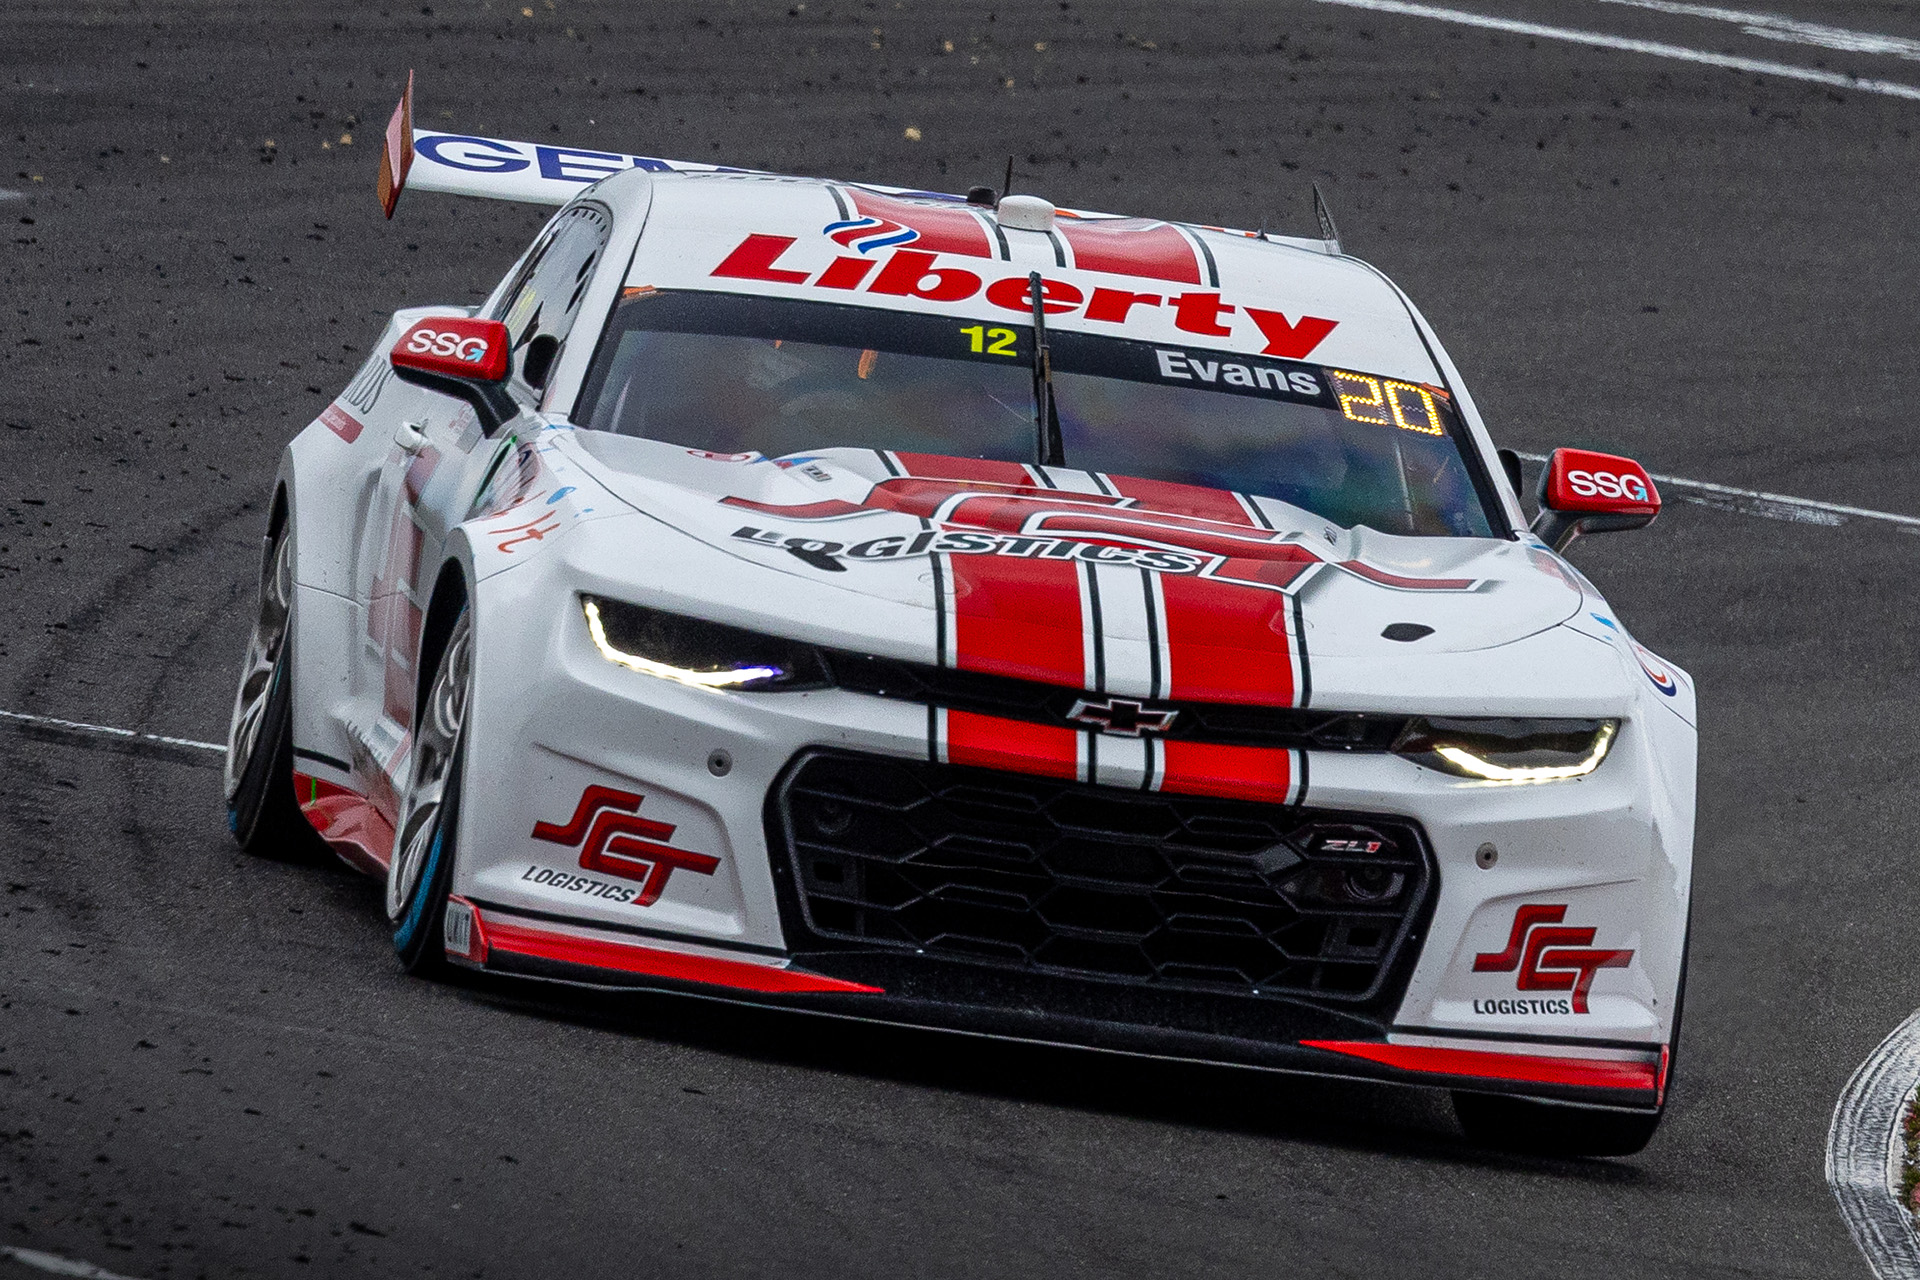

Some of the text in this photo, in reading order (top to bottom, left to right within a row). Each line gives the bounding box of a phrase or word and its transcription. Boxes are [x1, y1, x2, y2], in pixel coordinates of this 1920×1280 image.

[709, 233, 1340, 360] Liberty
[407, 328, 489, 363] SSG
[959, 325, 1018, 357] 12
[1155, 349, 1321, 395] Evans
[1333, 370, 1444, 436] 20
[1567, 469, 1649, 502] SSG
[729, 524, 1204, 574] LOGISTICS
[531, 784, 722, 908] SCT
[521, 865, 638, 904] LOGISTICS
[1472, 904, 1636, 1015] SCT
[1473, 999, 1570, 1015] LOGISTICS
